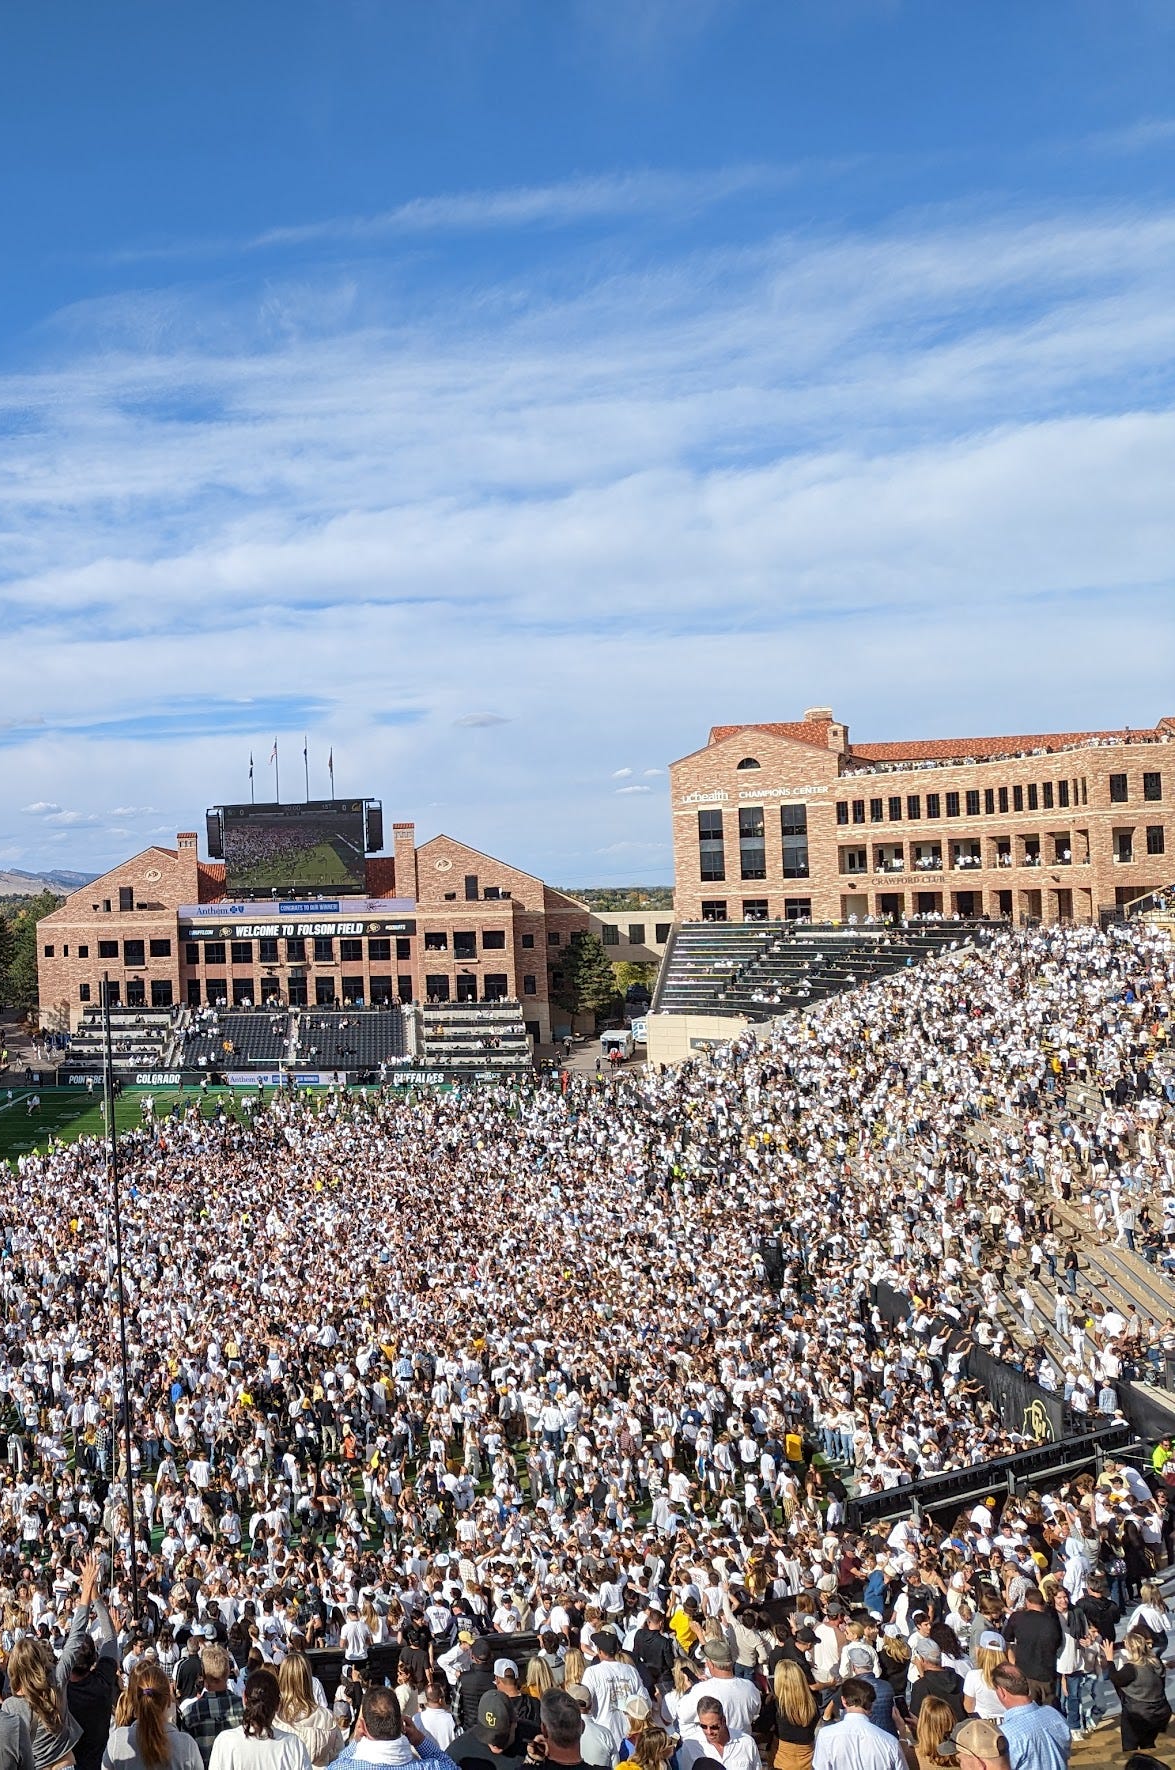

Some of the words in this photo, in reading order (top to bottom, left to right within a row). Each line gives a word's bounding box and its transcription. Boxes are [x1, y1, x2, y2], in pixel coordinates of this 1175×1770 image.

[682, 788, 728, 803] uchealth
[739, 788, 790, 799] CHAMPIONS
[792, 785, 829, 795] CENTER
[871, 876, 920, 886] CRAWFORD
[921, 875, 946, 884] CLUB
[196, 906, 228, 915] Anthem
[236, 925, 279, 937] WELCOME
[282, 924, 294, 936] TO
[297, 923, 336, 936] FOLSOM
[337, 922, 364, 935] FIELD
[136, 1074, 181, 1084] COLORADO
[485, 1711, 497, 1726] CU
